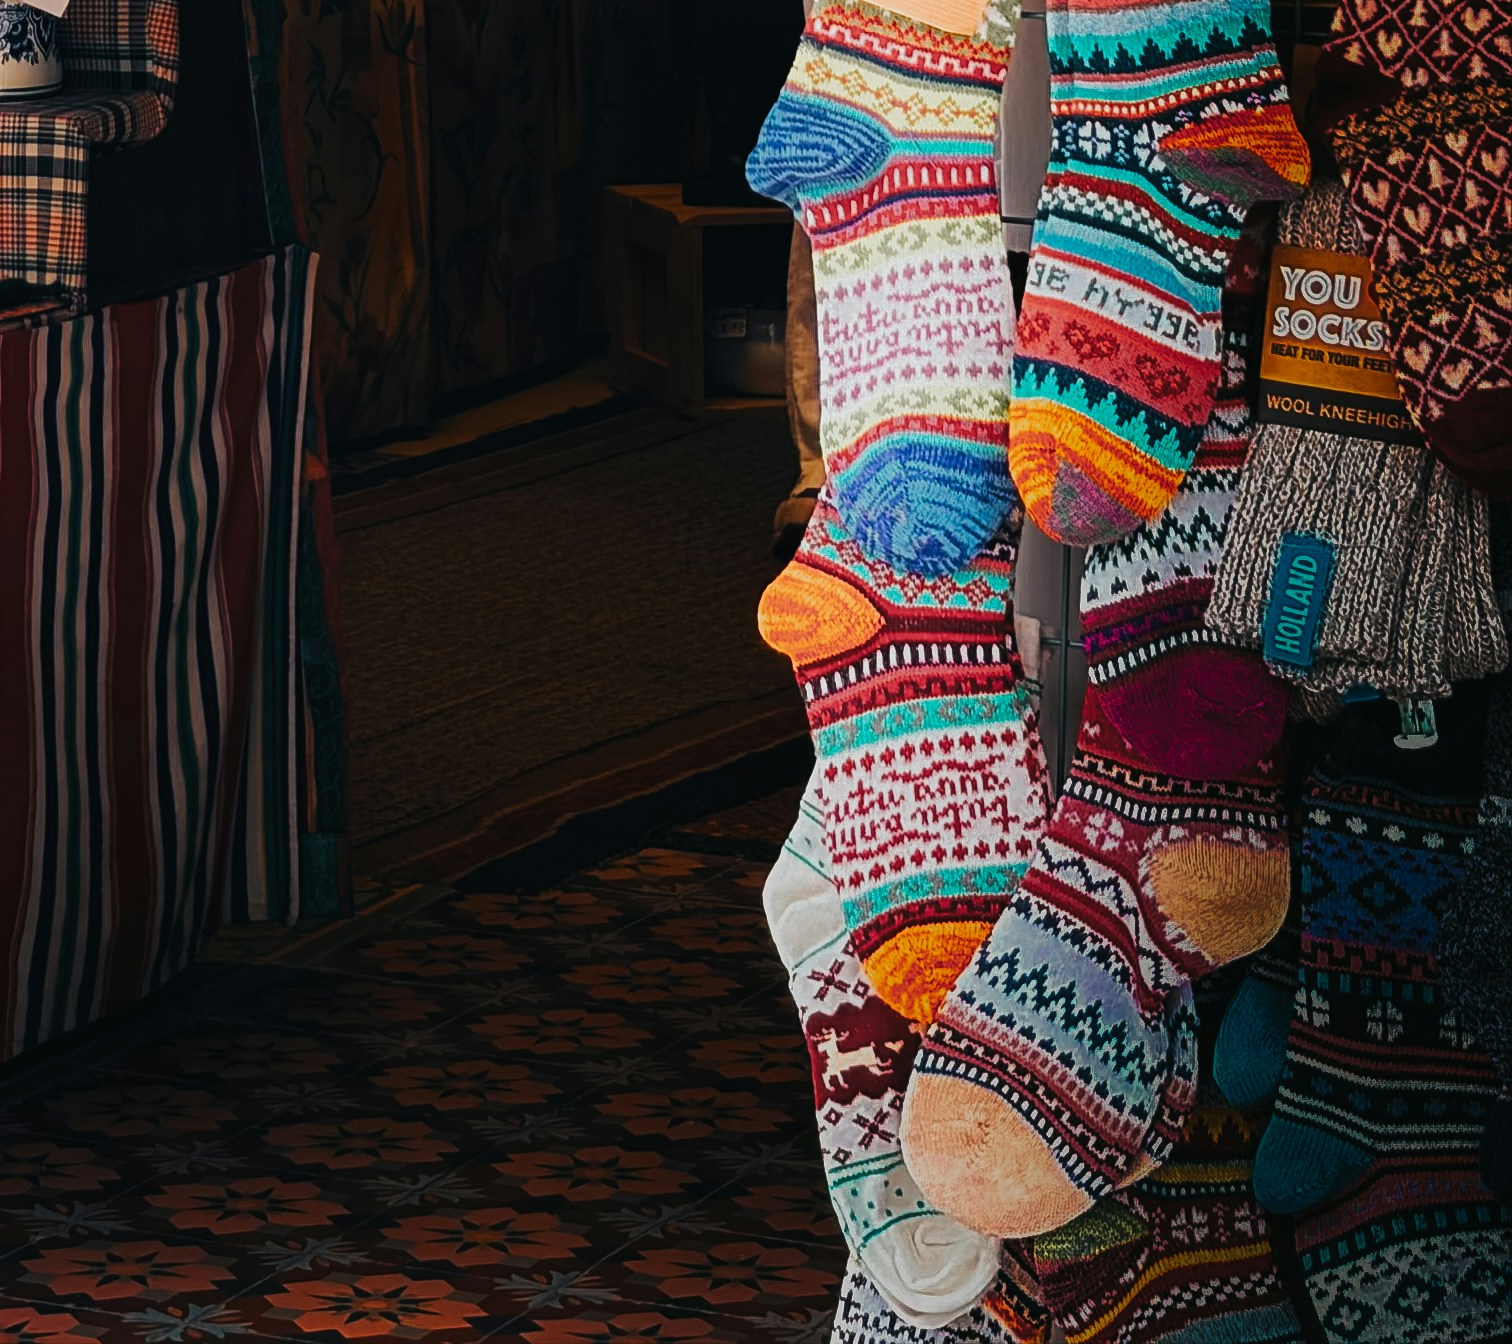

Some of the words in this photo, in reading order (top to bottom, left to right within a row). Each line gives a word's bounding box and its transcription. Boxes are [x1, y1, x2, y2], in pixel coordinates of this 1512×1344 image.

[1279, 264, 1361, 310] YOU
[1271, 343, 1299, 358] HEAT
[1300, 346, 1325, 362] FOR
[1327, 348, 1361, 367] YOUR
[1265, 393, 1316, 417] WOOL
[1274, 553, 1319, 654] HOLLAND
